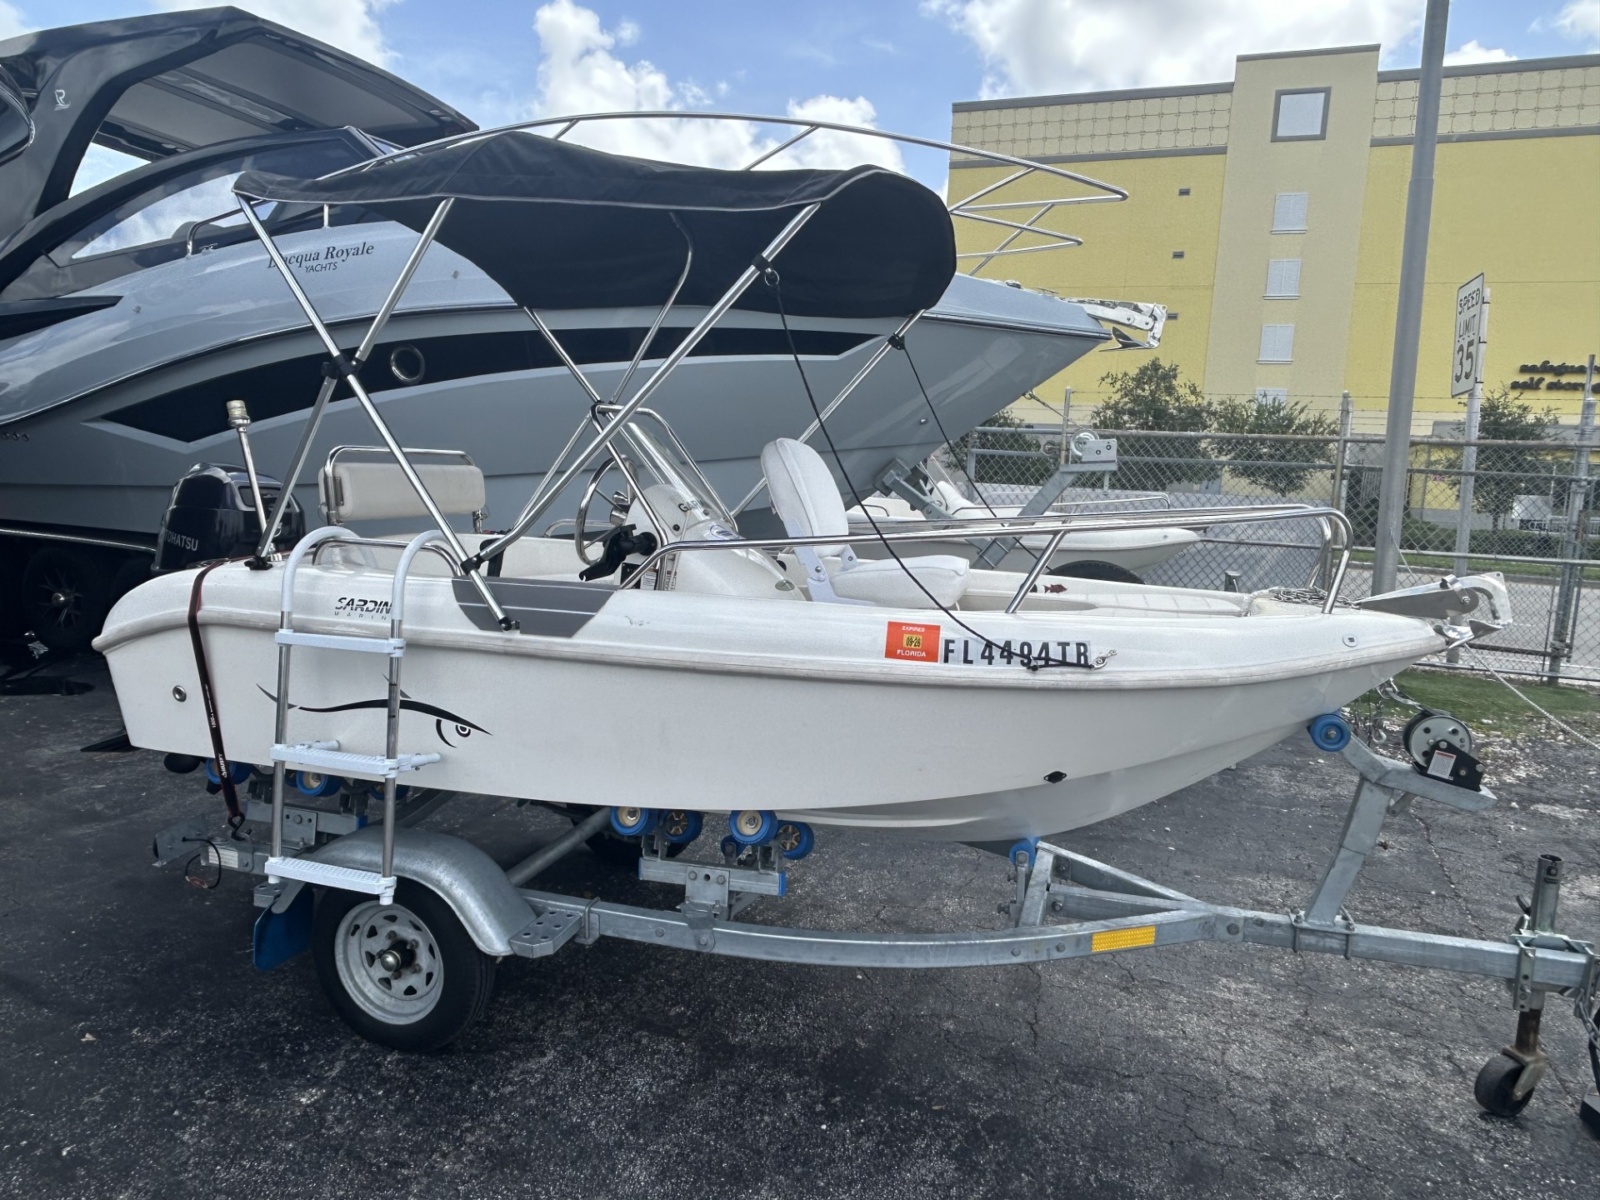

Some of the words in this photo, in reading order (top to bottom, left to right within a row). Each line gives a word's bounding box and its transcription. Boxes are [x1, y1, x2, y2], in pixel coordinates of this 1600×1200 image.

[323, 241, 374, 262] Royale
[304, 261, 338, 273] YACHTS
[1459, 288, 1480, 315] SPEED
[1458, 314, 1476, 339] LIMIT
[1454, 339, 1475, 383] 35
[335, 597, 393, 614] SARDIN
[334, 611, 387, 620] MARIN
[896, 649, 927, 657] FLORIDA
